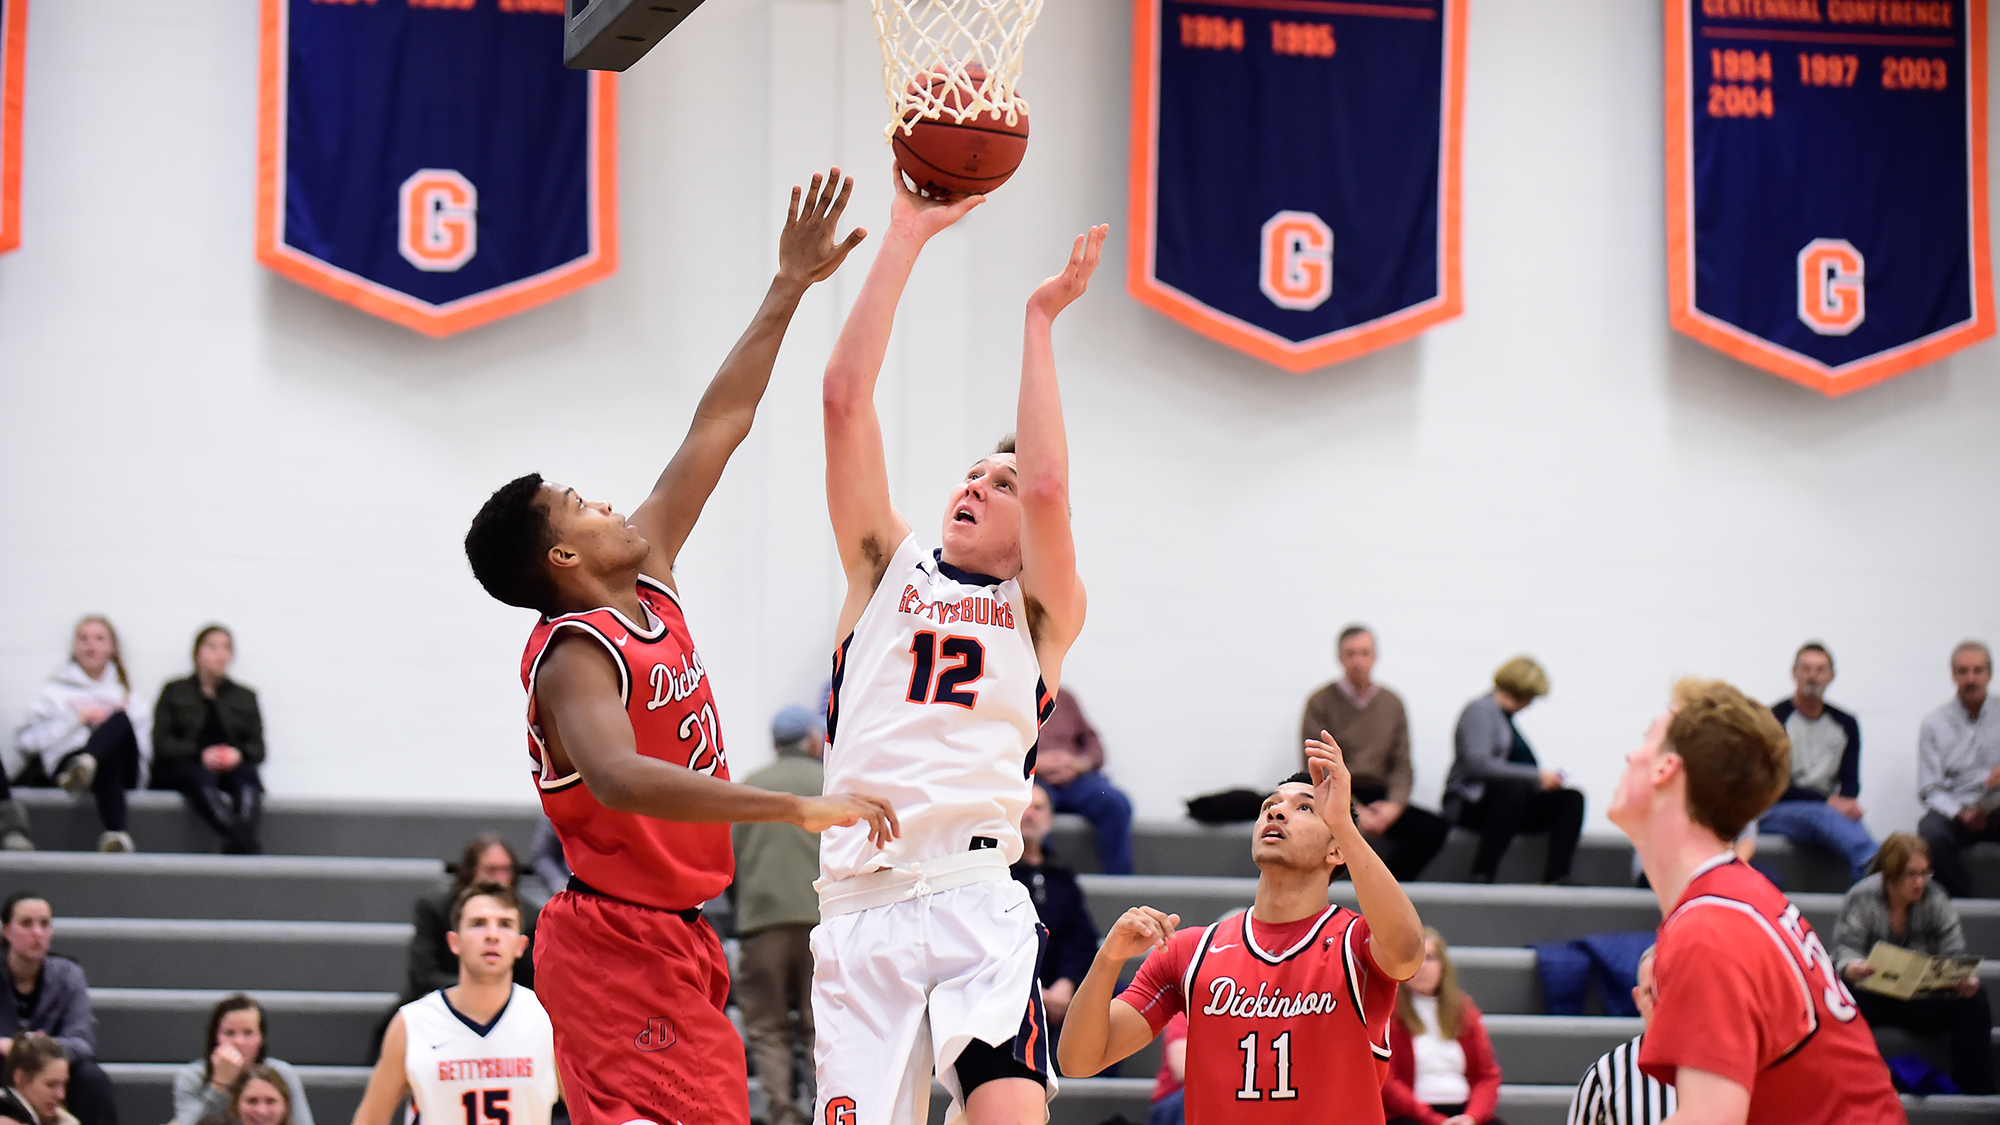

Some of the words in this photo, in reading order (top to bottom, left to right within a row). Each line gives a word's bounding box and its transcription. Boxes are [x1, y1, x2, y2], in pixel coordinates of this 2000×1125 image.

[1709, 47, 1773, 83] 1994
[1798, 52, 1859, 88] 1997
[1881, 55, 1948, 90] 2003
[1707, 83, 1774, 119] 2004
[398, 168, 477, 272] G
[1259, 209, 1334, 312] G
[1796, 237, 1865, 336] G
[898, 584, 1015, 630] GETTYSBURG
[905, 629, 986, 710] 12
[1202, 976, 1338, 1020] Dickinson
[438, 1057, 534, 1081] GETTYSBURG
[1235, 1031, 1298, 1101] 11
[460, 1087, 512, 1125] 15
